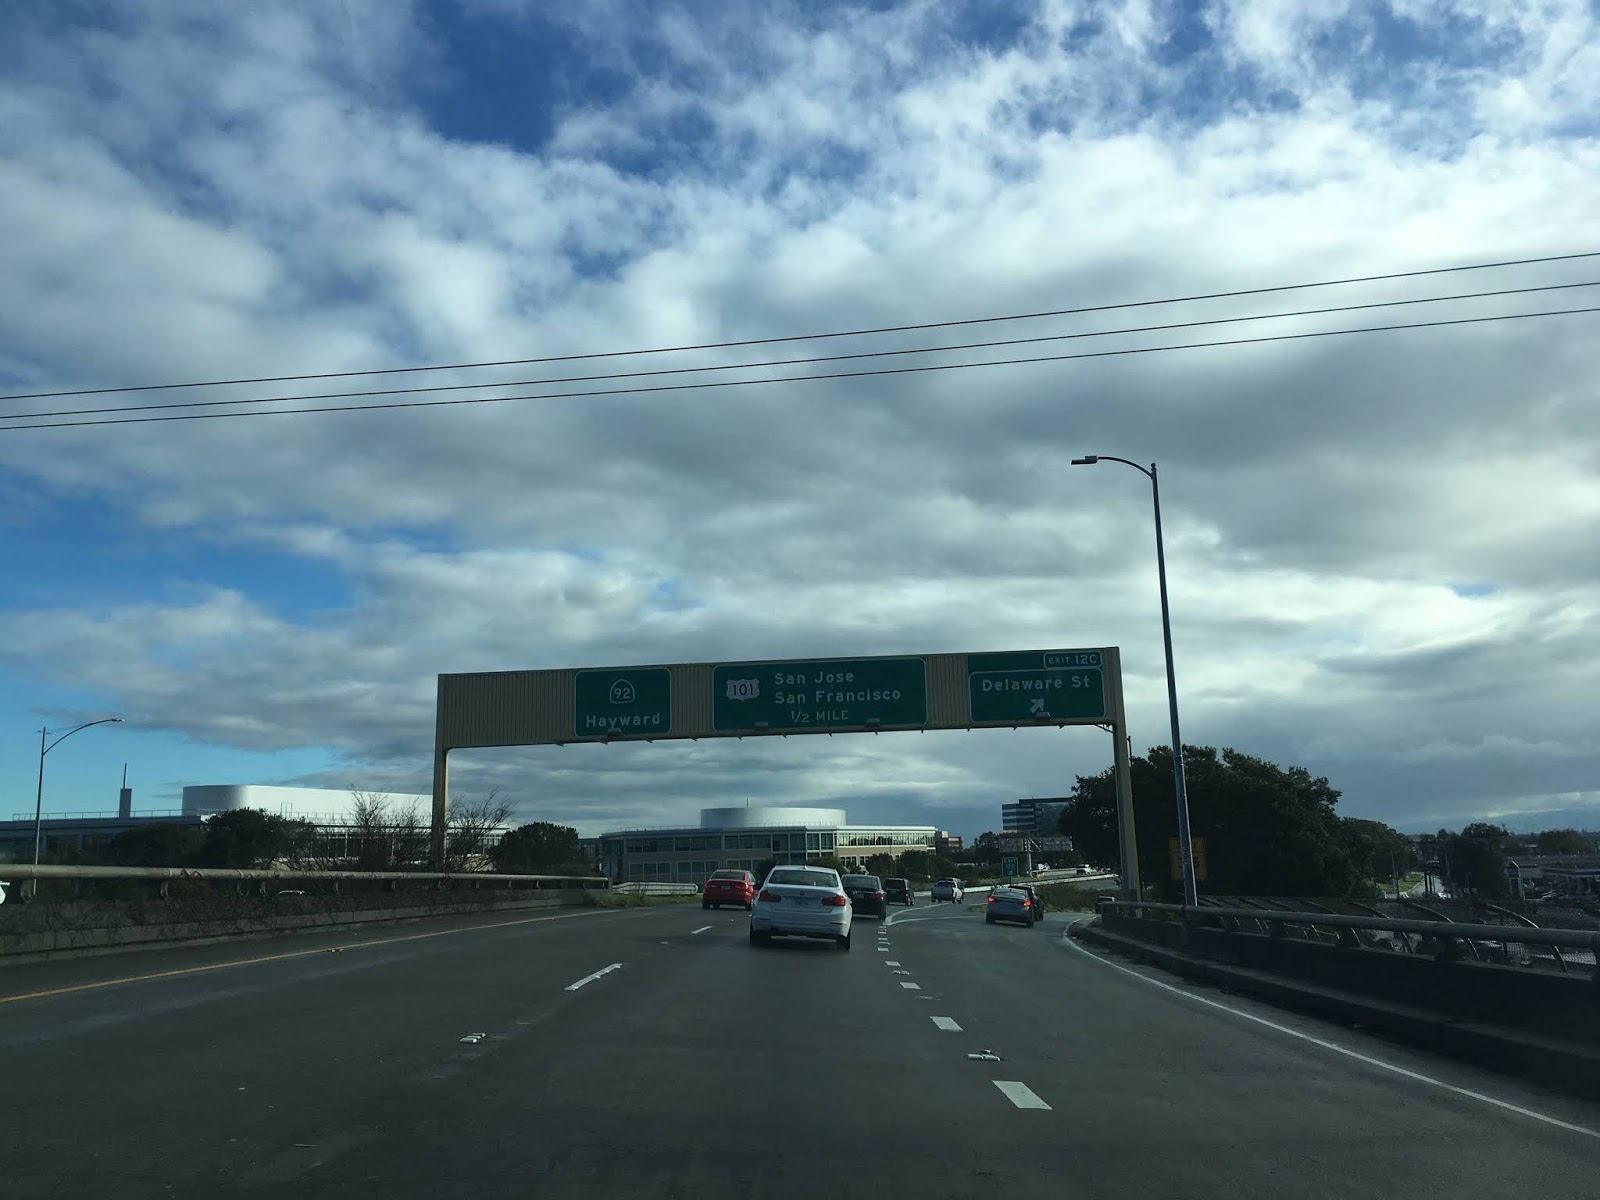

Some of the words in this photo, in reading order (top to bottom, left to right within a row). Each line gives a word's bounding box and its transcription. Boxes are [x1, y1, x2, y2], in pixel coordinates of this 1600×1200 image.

[1048, 656, 1070, 664] EXIT
[1075, 654, 1097, 664] 12C
[774, 673, 806, 685] San
[814, 671, 854, 684] Jose
[982, 679, 1063, 692] Delaware
[1071, 675, 1090, 688] St
[613, 687, 631, 699] 92
[733, 683, 755, 696] 101
[775, 691, 806, 704] San
[815, 688, 901, 703] Francisco
[585, 713, 661, 728] Hayward
[790, 710, 810, 723] 1/2
[816, 709, 848, 721] MILE
